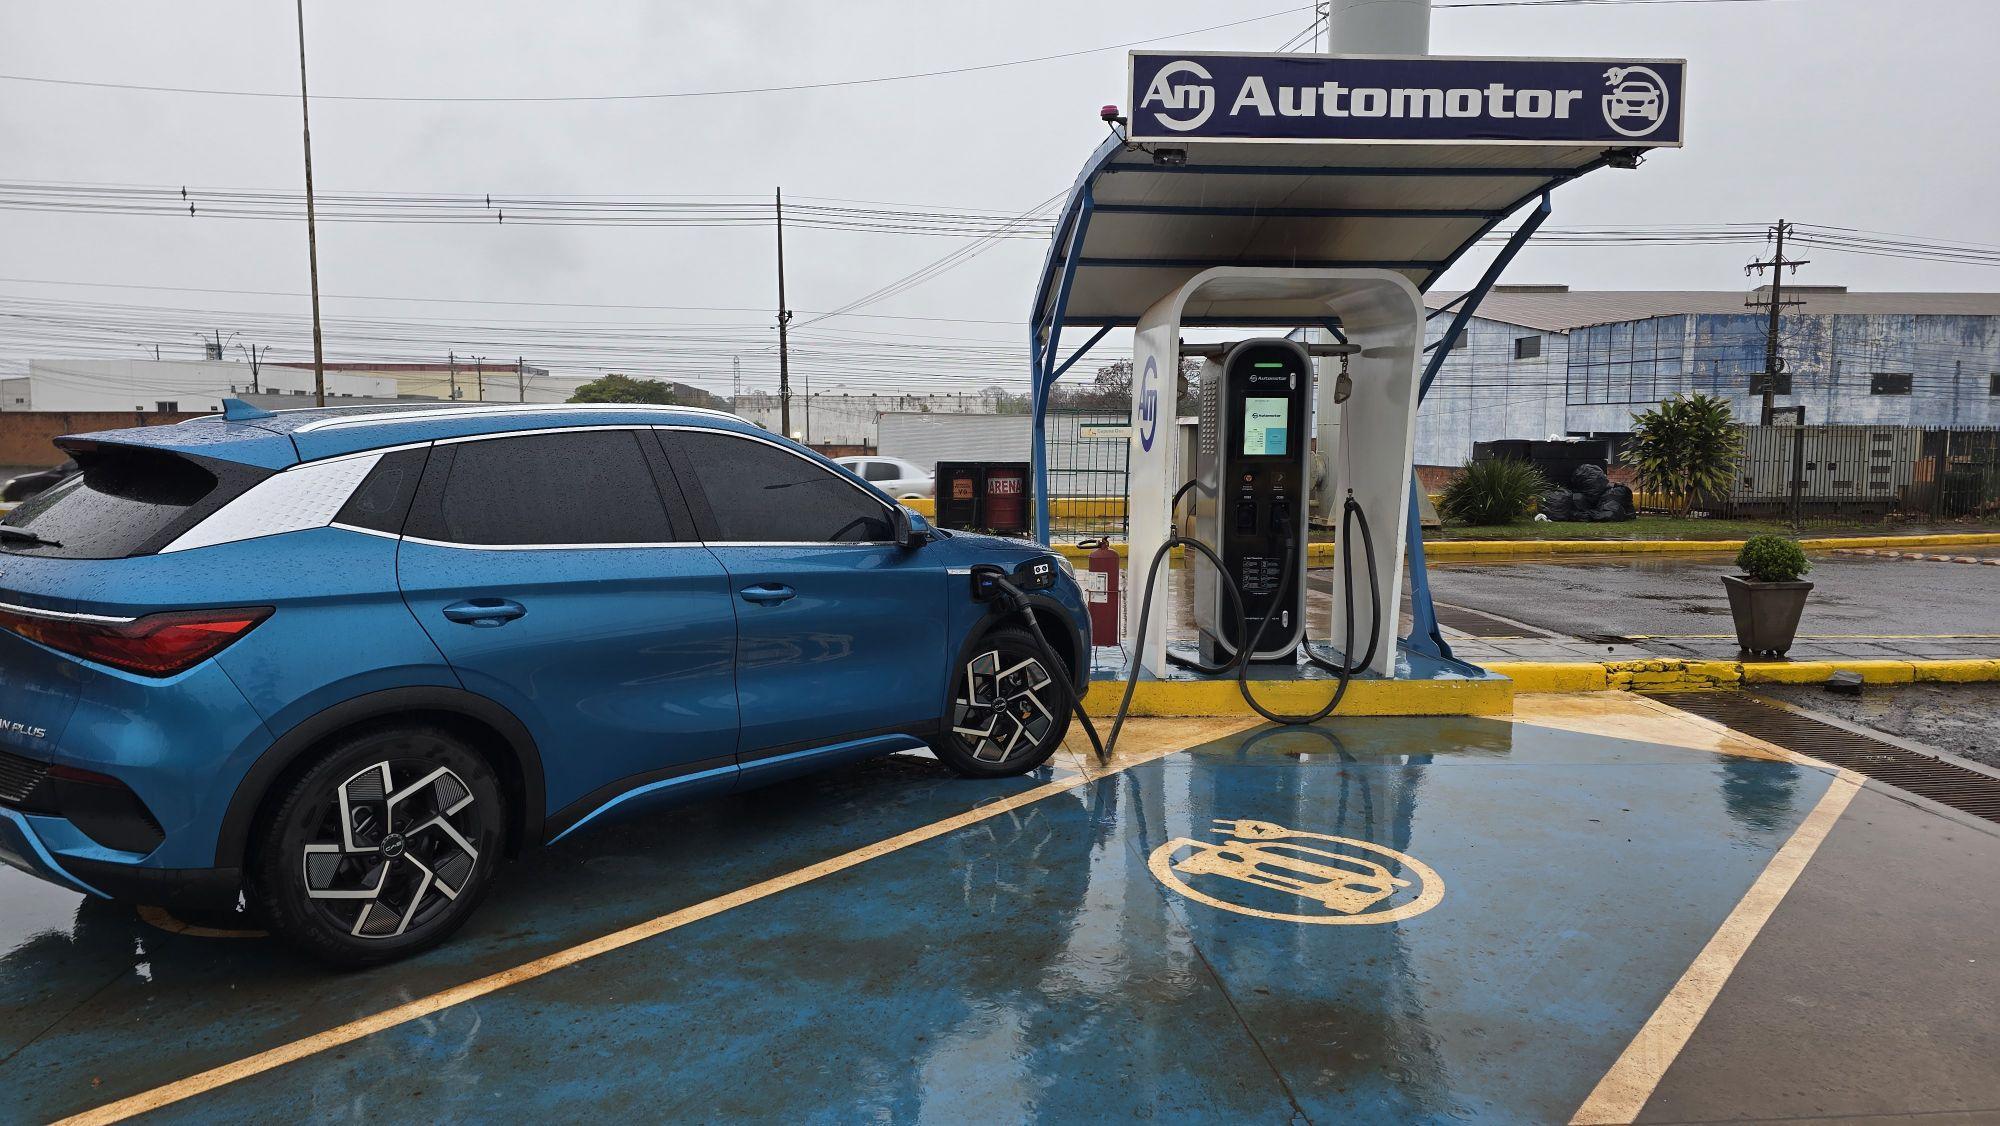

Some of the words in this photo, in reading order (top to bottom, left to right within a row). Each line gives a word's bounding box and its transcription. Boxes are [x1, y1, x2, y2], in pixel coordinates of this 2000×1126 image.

[1229, 75, 1583, 119] Automotor
[987, 478, 1023, 494] ARENA
[0, 718, 10, 730] N
[12, 722, 46, 738] PLUS
